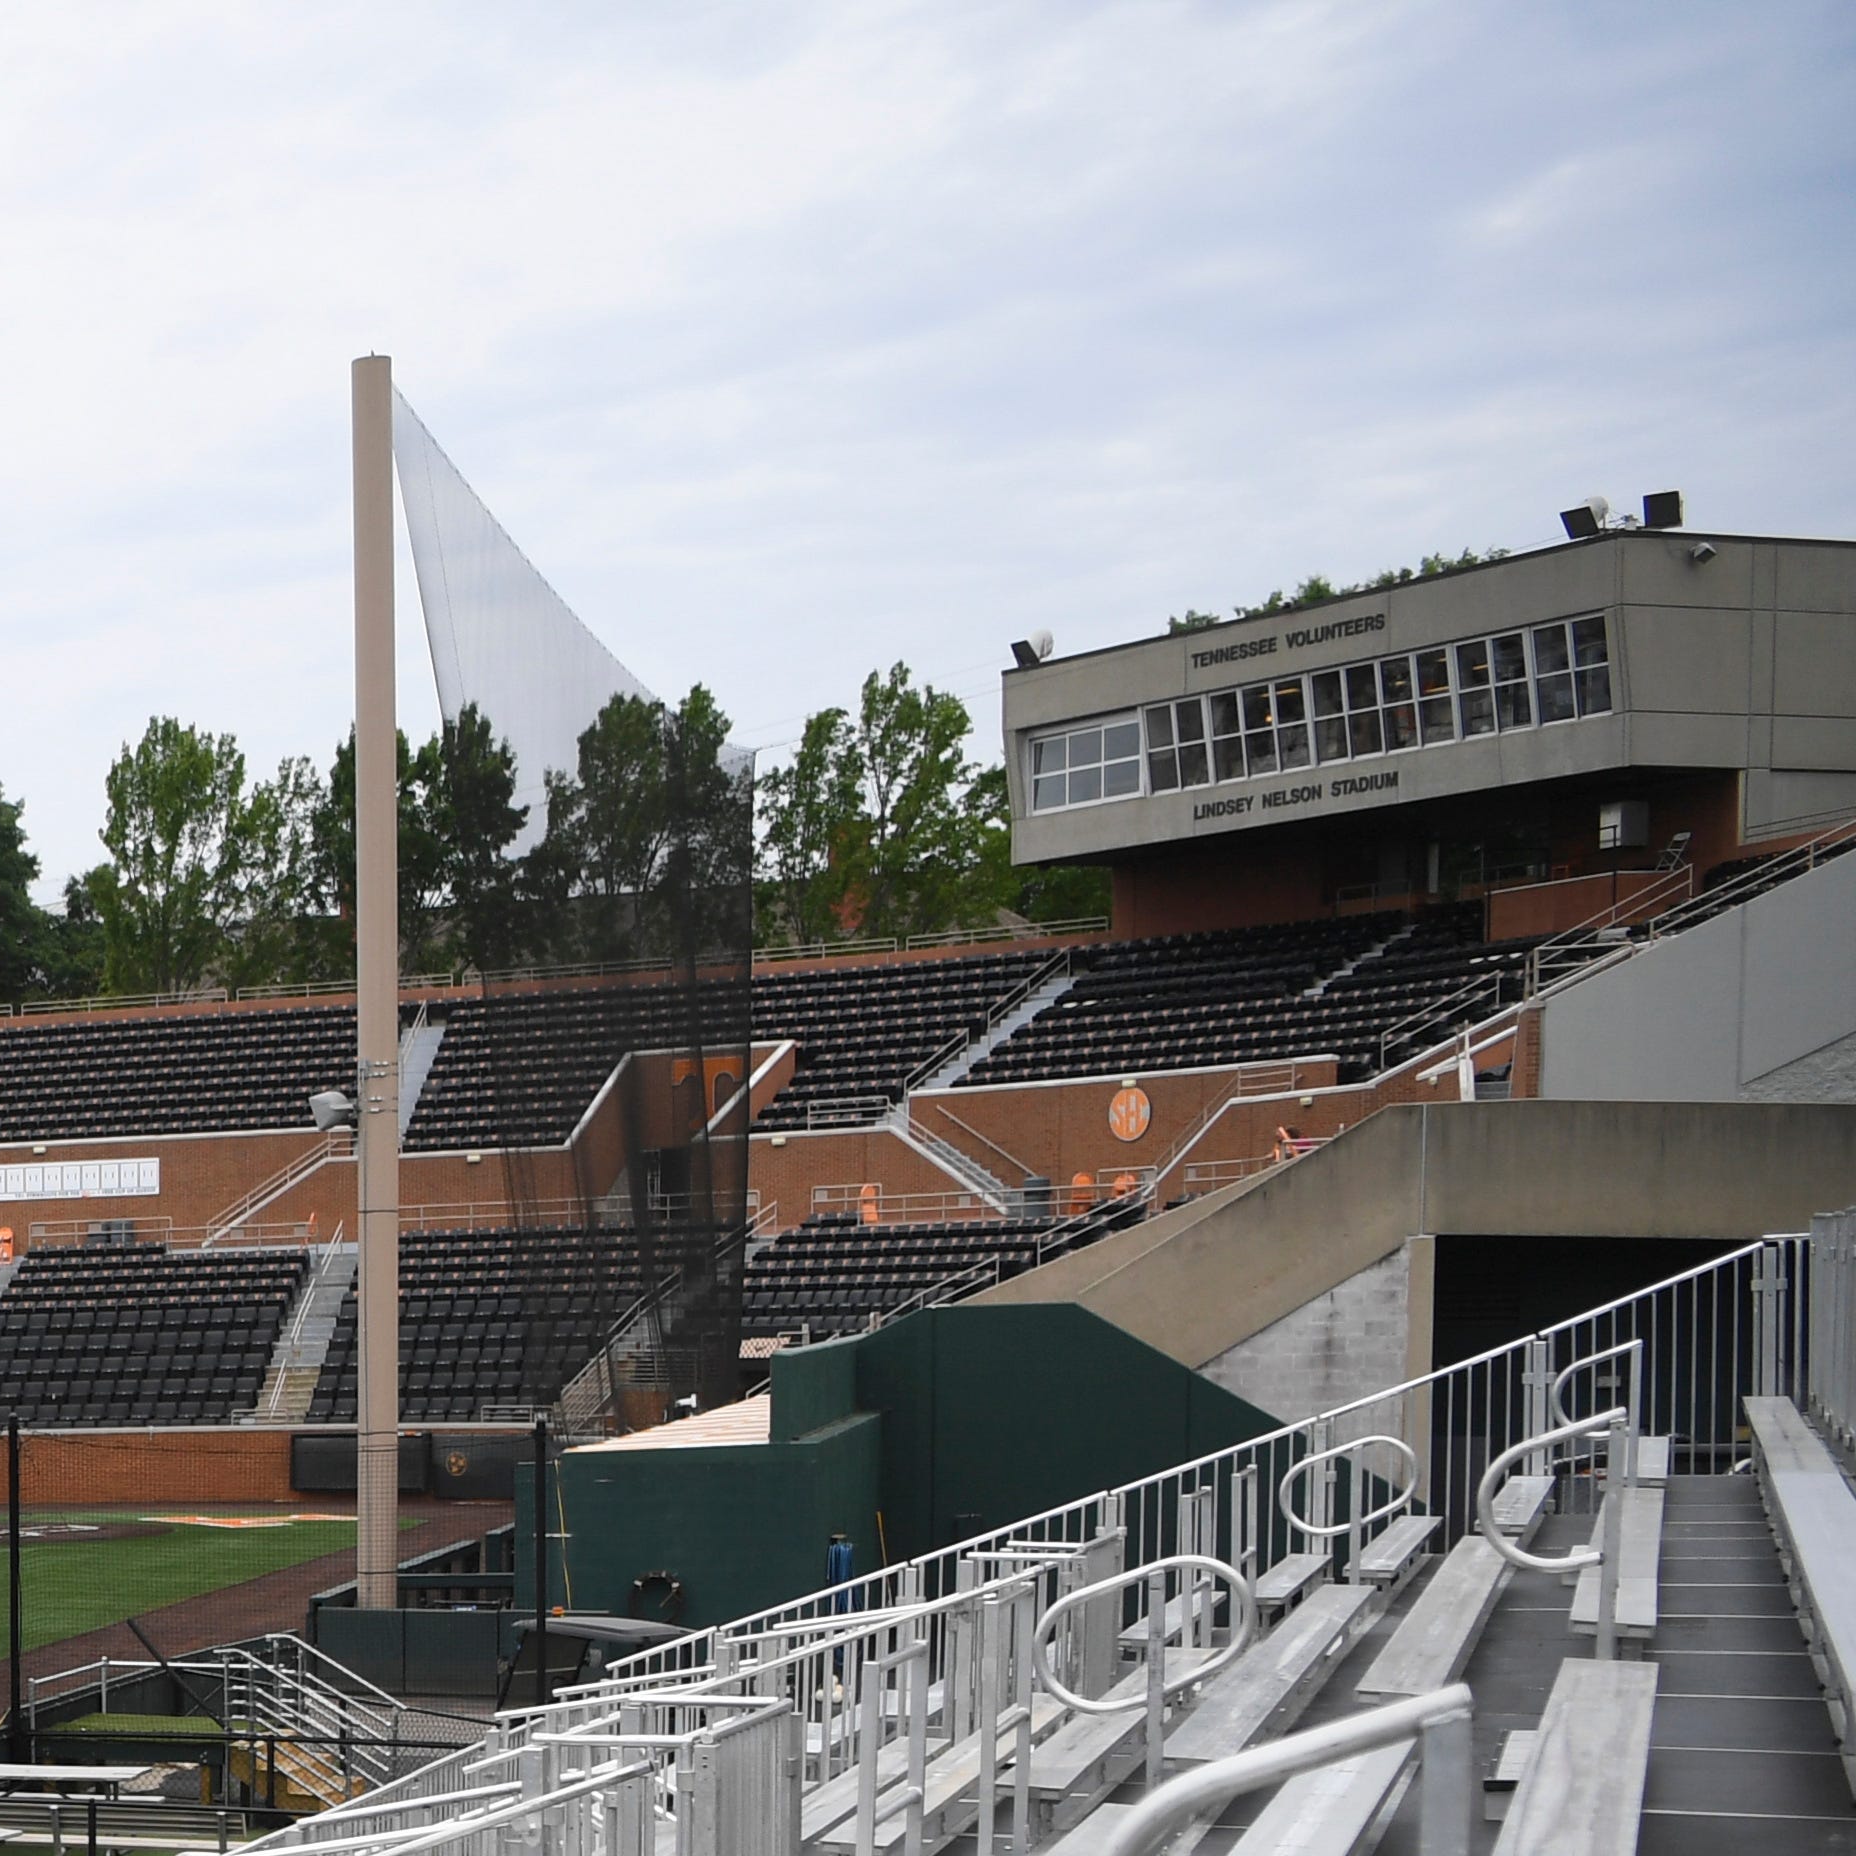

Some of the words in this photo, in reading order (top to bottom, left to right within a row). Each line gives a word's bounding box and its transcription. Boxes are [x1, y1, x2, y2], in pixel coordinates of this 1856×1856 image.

[1191, 637, 1278, 669] TENNESSEE
[1286, 613, 1385, 649] VOLUNTEERS
[1194, 796, 1254, 821] LINDSEY
[1262, 784, 1322, 810] NELSON
[1331, 771, 1399, 797] STADIUM
